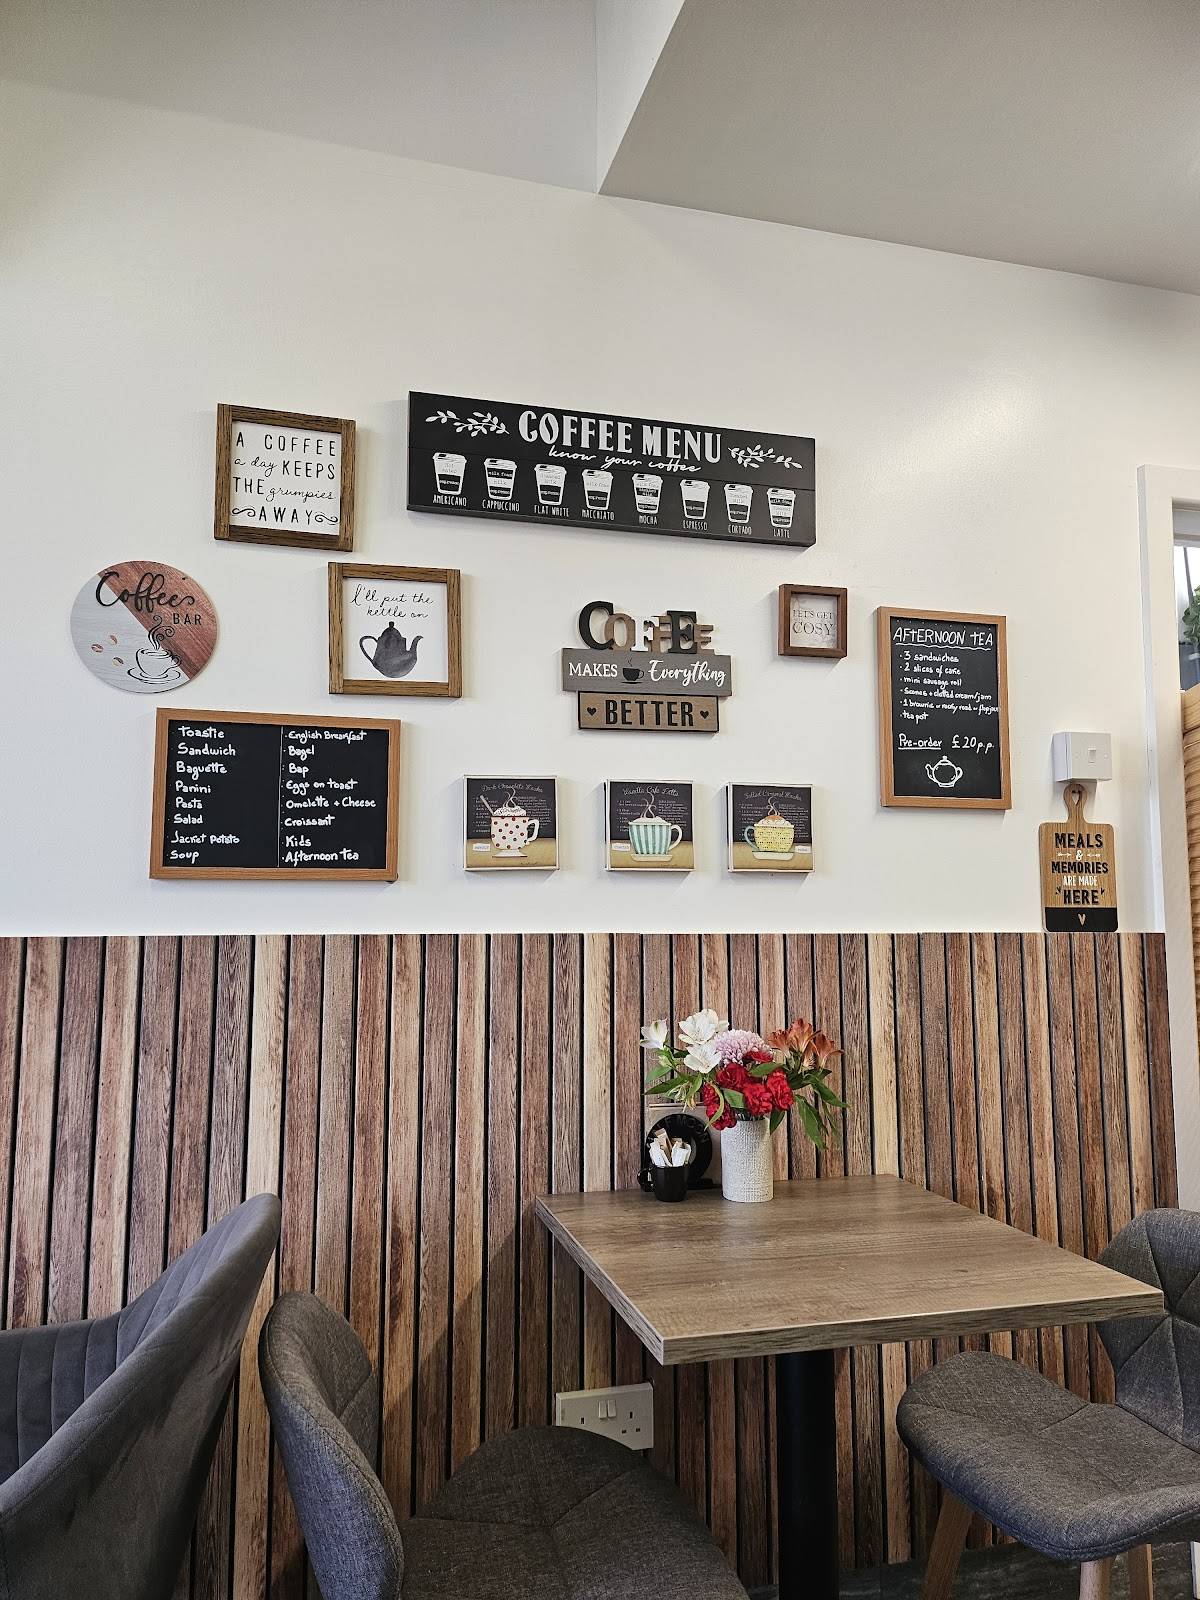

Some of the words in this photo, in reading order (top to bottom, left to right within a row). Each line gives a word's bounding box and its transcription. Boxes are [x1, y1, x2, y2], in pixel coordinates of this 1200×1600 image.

[236, 431, 244, 448] A
[264, 434, 336, 457] COFFEE
[518, 410, 633, 454] COFFEE
[641, 424, 721, 464] MENU
[548, 445, 597, 462] know
[600, 455, 642, 472] your
[648, 459, 702, 473] coffee
[234, 458, 246, 466] a
[250, 456, 278, 478] day
[282, 459, 336, 480] KEEPS
[233, 476, 265, 495] THE
[265, 487, 338, 504] grumpies
[432, 493, 468, 507] AMERICANO
[482, 498, 520, 513] CAPPUCCINO
[258, 505, 313, 525] AWAY
[534, 504, 550, 515] FLAT
[551, 506, 570, 518] WHITE
[581, 509, 616, 521] MACCHIATO
[638, 514, 659, 525] MOCHA
[682, 519, 708, 531] ESPRESSO
[727, 524, 752, 536] CORTADO
[773, 528, 791, 538] LATTE
[95, 571, 195, 613] Coffee
[379, 593, 407, 607] put
[412, 592, 434, 604] the
[172, 612, 202, 626] BAR
[366, 606, 407, 618] kettle
[792, 621, 834, 636] COSY
[903, 650, 911, 661] 3
[913, 652, 960, 663] sandwiches
[568, 662, 618, 678] MAKES
[648, 659, 727, 687] Everything
[903, 662, 911, 672] 2
[913, 664, 934, 674] slices
[935, 664, 944, 678] of
[944, 667, 962, 676] cake
[903, 676, 921, 685] mini
[922, 677, 950, 690] sausage
[950, 678, 963, 687] roll
[902, 699, 908, 707] 1
[908, 698, 935, 709] brownie
[958, 702, 973, 712] road
[605, 699, 694, 727] BETTER
[902, 710, 915, 721] tea
[914, 711, 929, 725] pot
[178, 725, 225, 738] Toastie
[287, 730, 323, 744] English
[324, 731, 368, 745] Breakfast
[898, 732, 943, 747] Pre-order
[177, 742, 237, 756] Sandwich
[287, 744, 315, 761] Bagel
[175, 760, 228, 781] Baguette
[288, 762, 310, 779] Bap
[175, 780, 212, 794] Panini
[285, 779, 311, 796] Eggs
[313, 780, 326, 788] on
[326, 777, 359, 790] toast
[175, 796, 204, 809] Pasta
[285, 795, 330, 809] Omelette
[341, 795, 377, 808] Cheese
[173, 813, 204, 825] Salad
[284, 814, 336, 827] Croissant
[170, 830, 207, 844] Jacket
[285, 834, 312, 848] Kids
[1054, 832, 1104, 849] MEALS
[169, 849, 200, 865] Soup
[284, 849, 338, 867] Afternoon
[338, 847, 360, 861] Tea
[1075, 849, 1084, 861] &
[1051, 861, 1109, 875] MEMORIES
[1063, 875, 1078, 886] ARE
[1078, 875, 1098, 887] MADE
[1063, 889, 1100, 906] HERE
